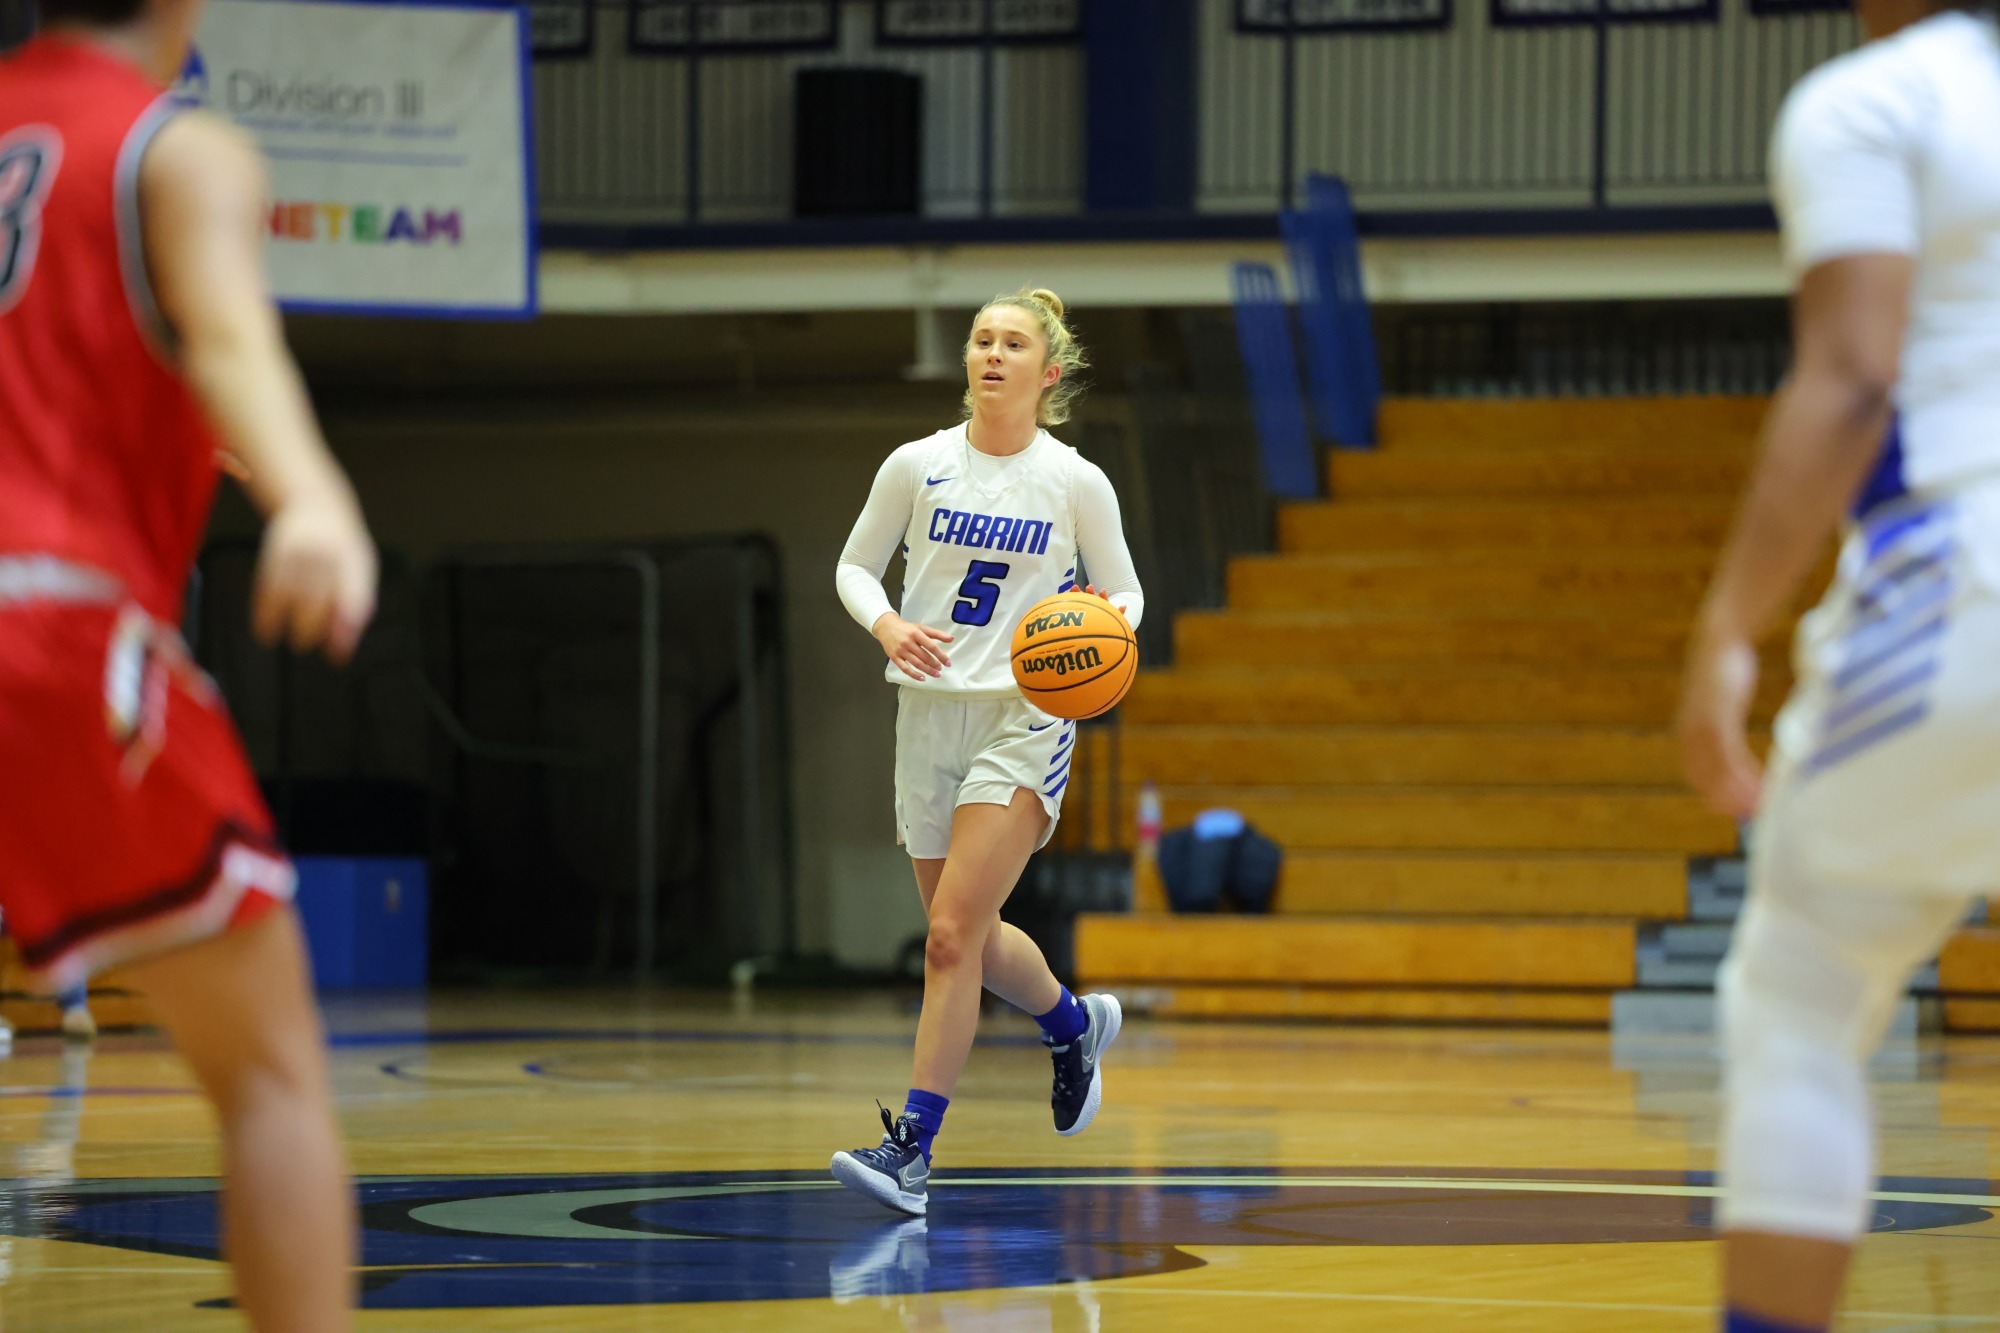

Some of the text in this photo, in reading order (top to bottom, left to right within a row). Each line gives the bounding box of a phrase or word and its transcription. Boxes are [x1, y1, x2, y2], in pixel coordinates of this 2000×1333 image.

[226, 69, 385, 115] Division
[928, 507, 1054, 555] CABRINI
[951, 559, 1010, 627] 5
[1025, 611, 1085, 639] NCAA
[1021, 645, 1103, 676] Wilson
